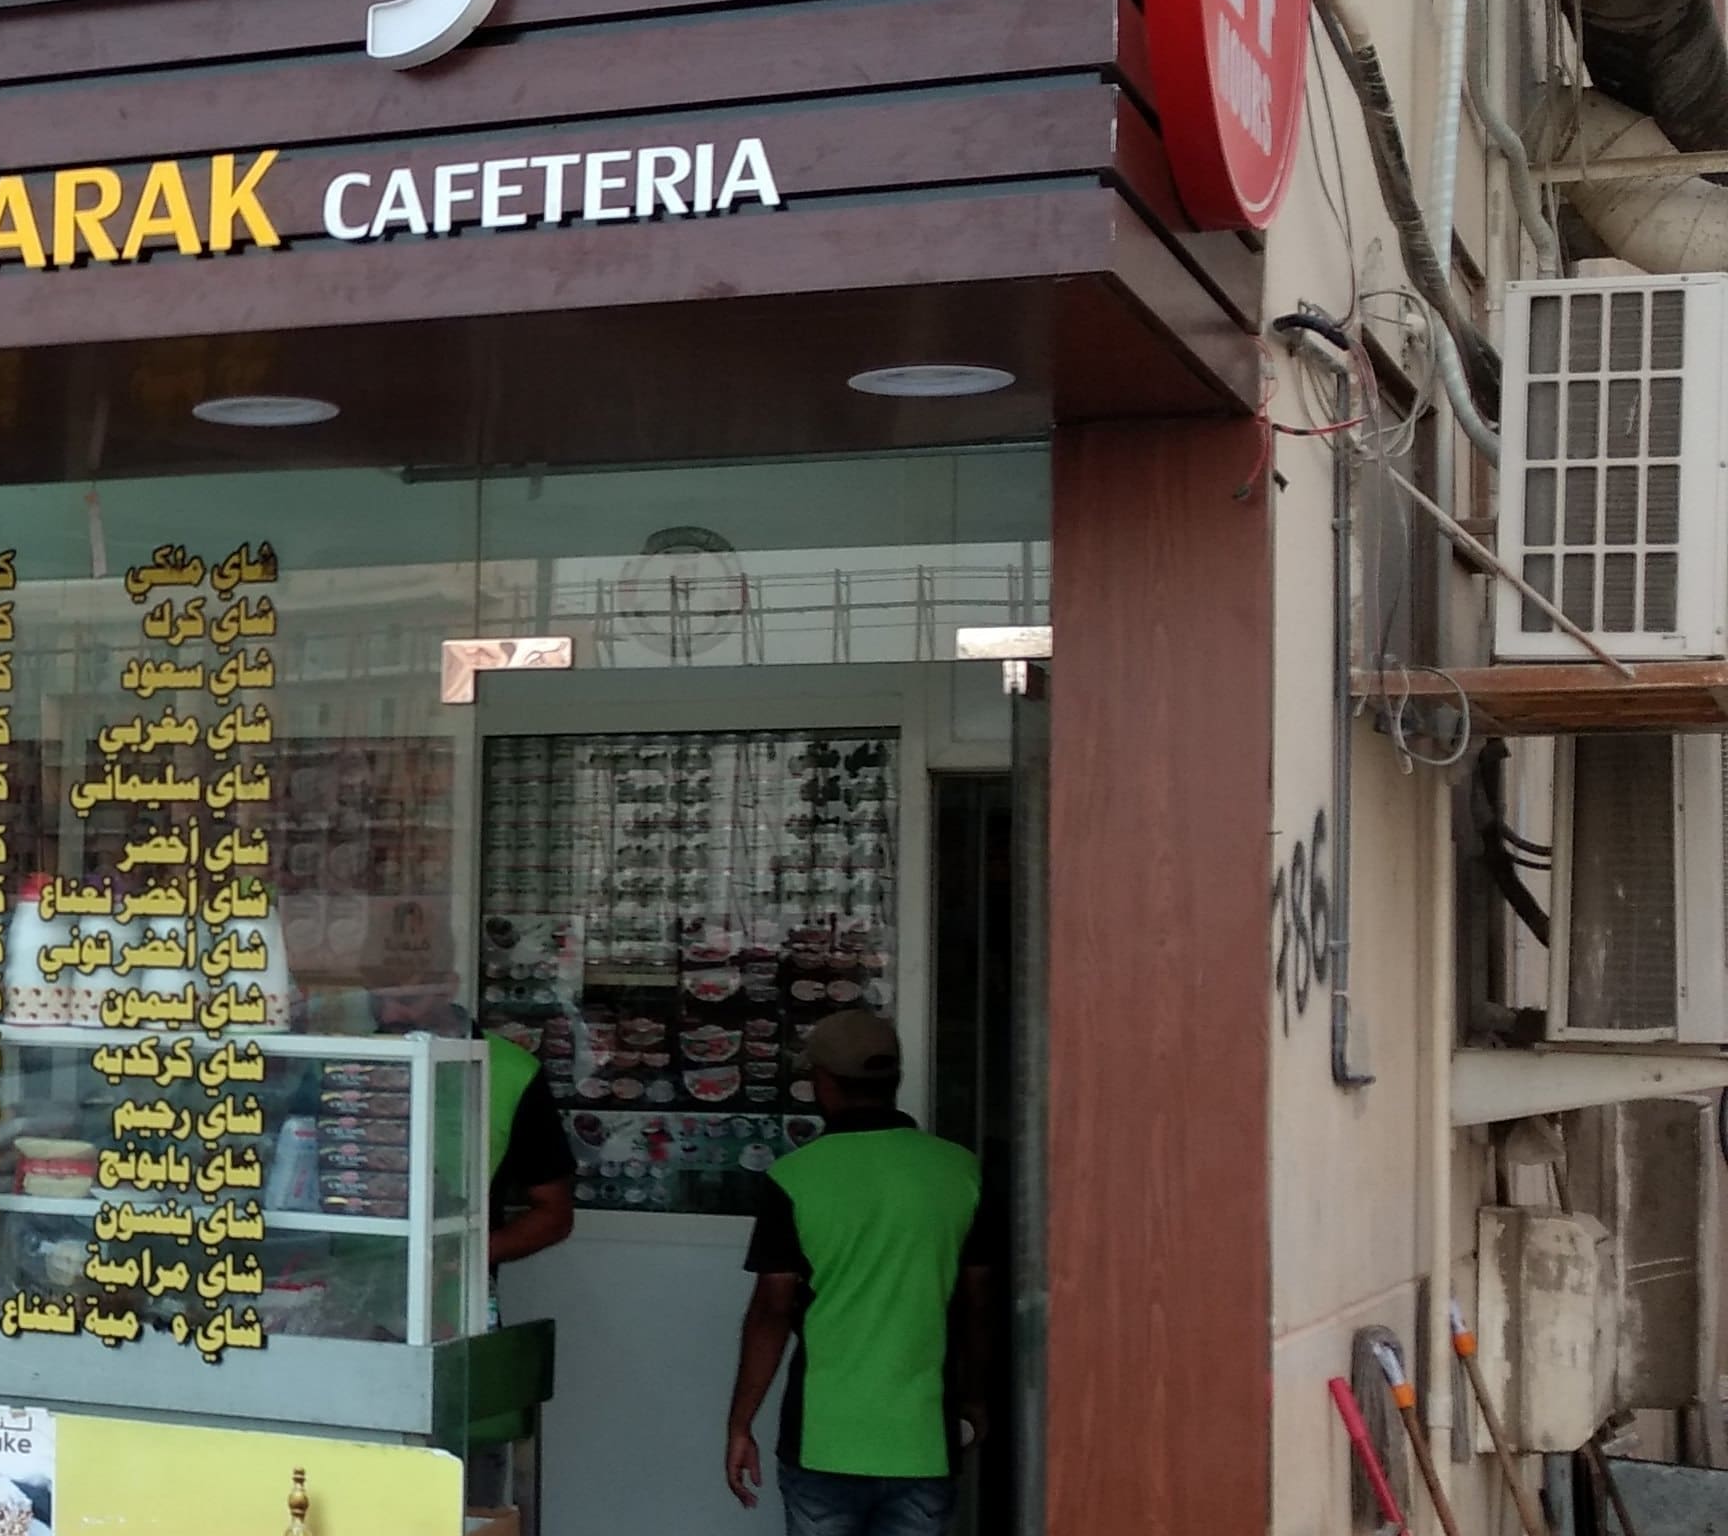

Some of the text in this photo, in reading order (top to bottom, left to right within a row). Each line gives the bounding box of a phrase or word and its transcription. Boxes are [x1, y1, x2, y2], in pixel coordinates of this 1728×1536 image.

[322, 137, 780, 242] CAFETERIA
[143, 598, 275, 654] شاي كرك
[208, 649, 274, 706] شاي
[97, 704, 272, 762] شاي مغربي
[69, 763, 271, 819] شاي سليماني
[114, 819, 269, 883] شاي أخضر
[37, 866, 268, 928] شاي أخضر نعناع
[98, 983, 268, 1035] شاي ليمون
[91, 1035, 265, 1097] شاي كركديه
[196, 1096, 263, 1144] شاي
[97, 1142, 262, 1200] شاي بابونج
[95, 1202, 264, 1252] شاي ينسون
[84, 1243, 263, 1306] شاي مرامية
